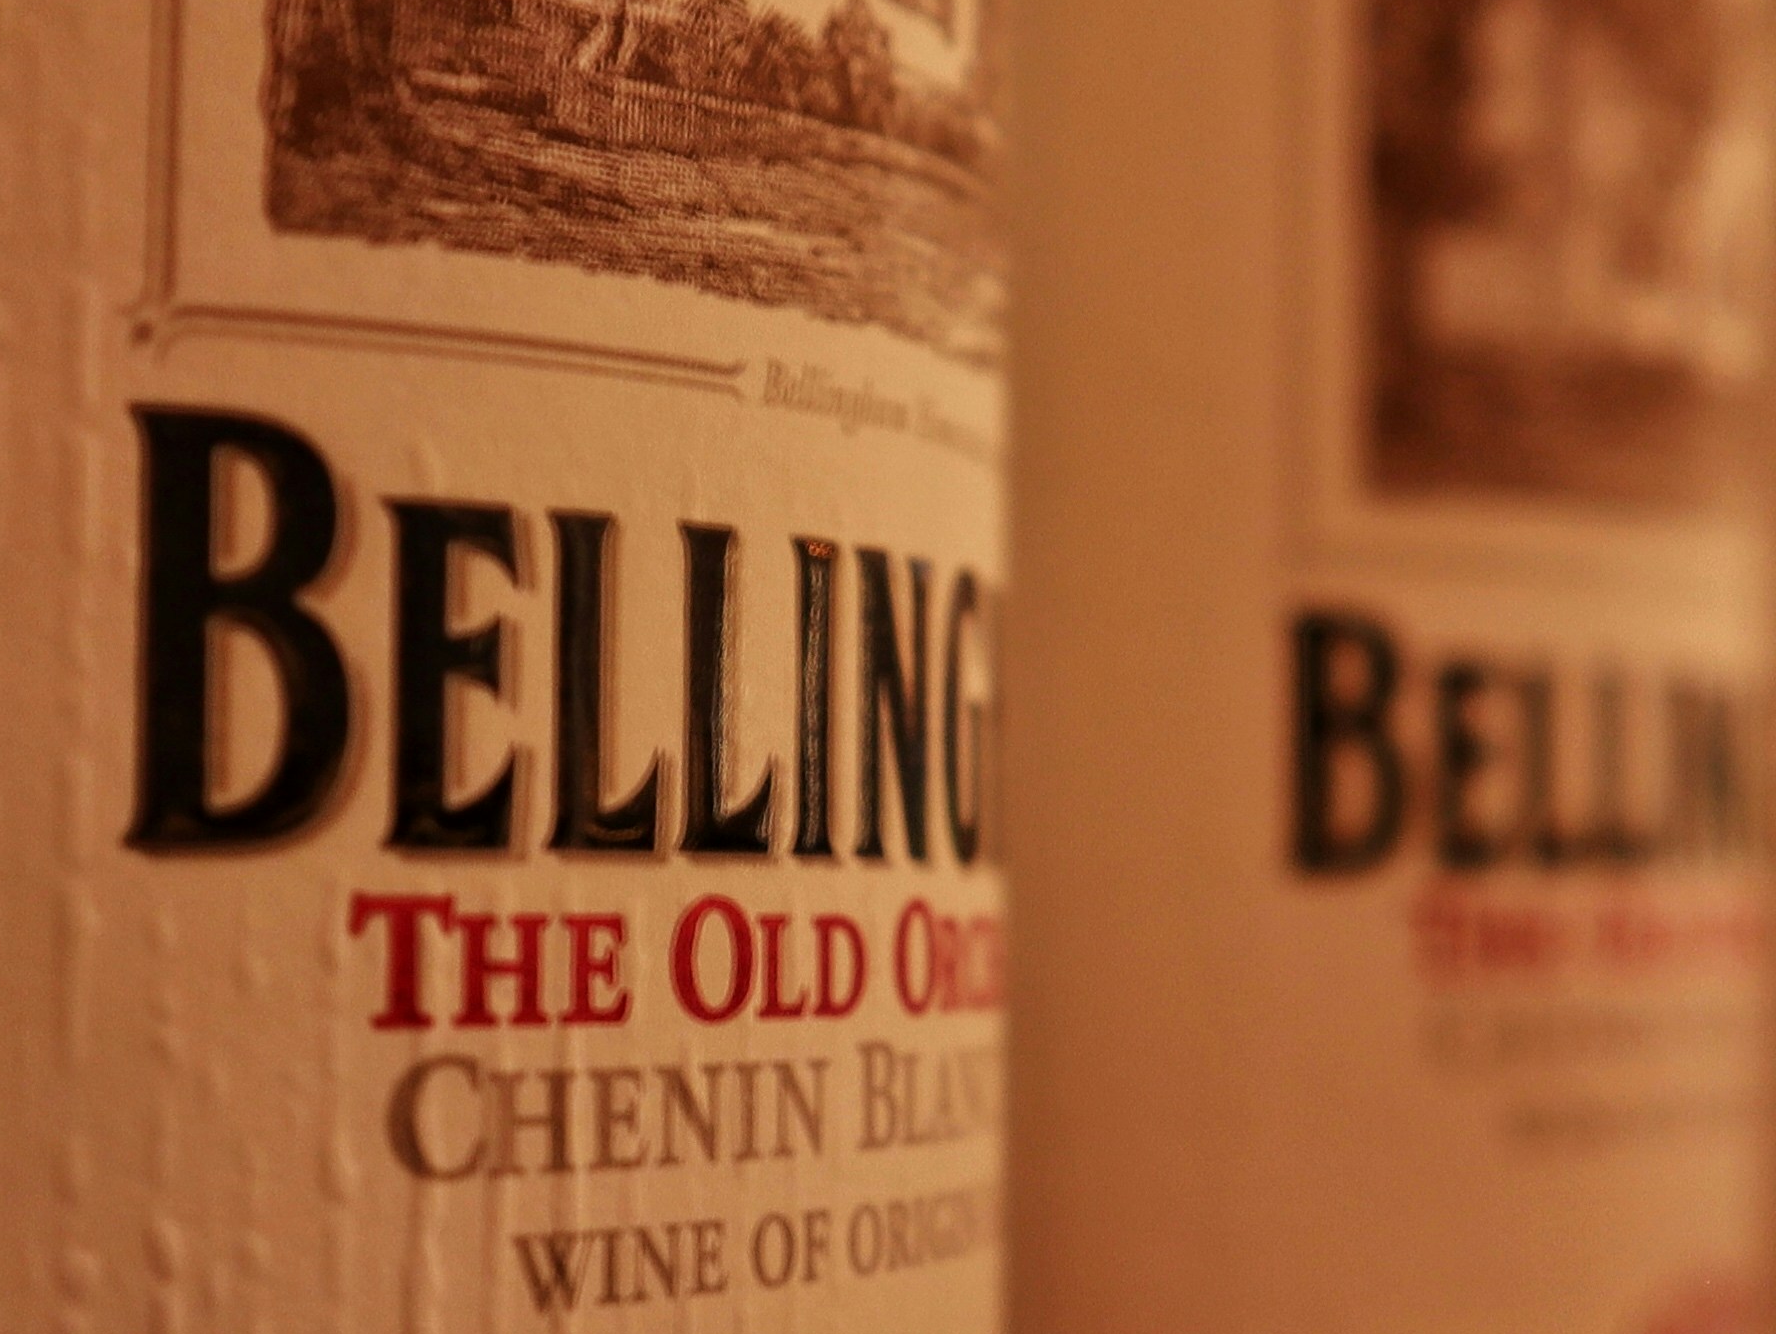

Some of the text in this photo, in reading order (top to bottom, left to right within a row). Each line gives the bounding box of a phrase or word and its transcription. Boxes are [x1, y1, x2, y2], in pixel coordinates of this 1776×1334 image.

[348, 892, 633, 1030] THE
[669, 893, 867, 1024] OLD
[384, 1053, 829, 1182] CHENIN
[512, 1218, 731, 1315] WINE
[749, 1208, 834, 1290] OF
